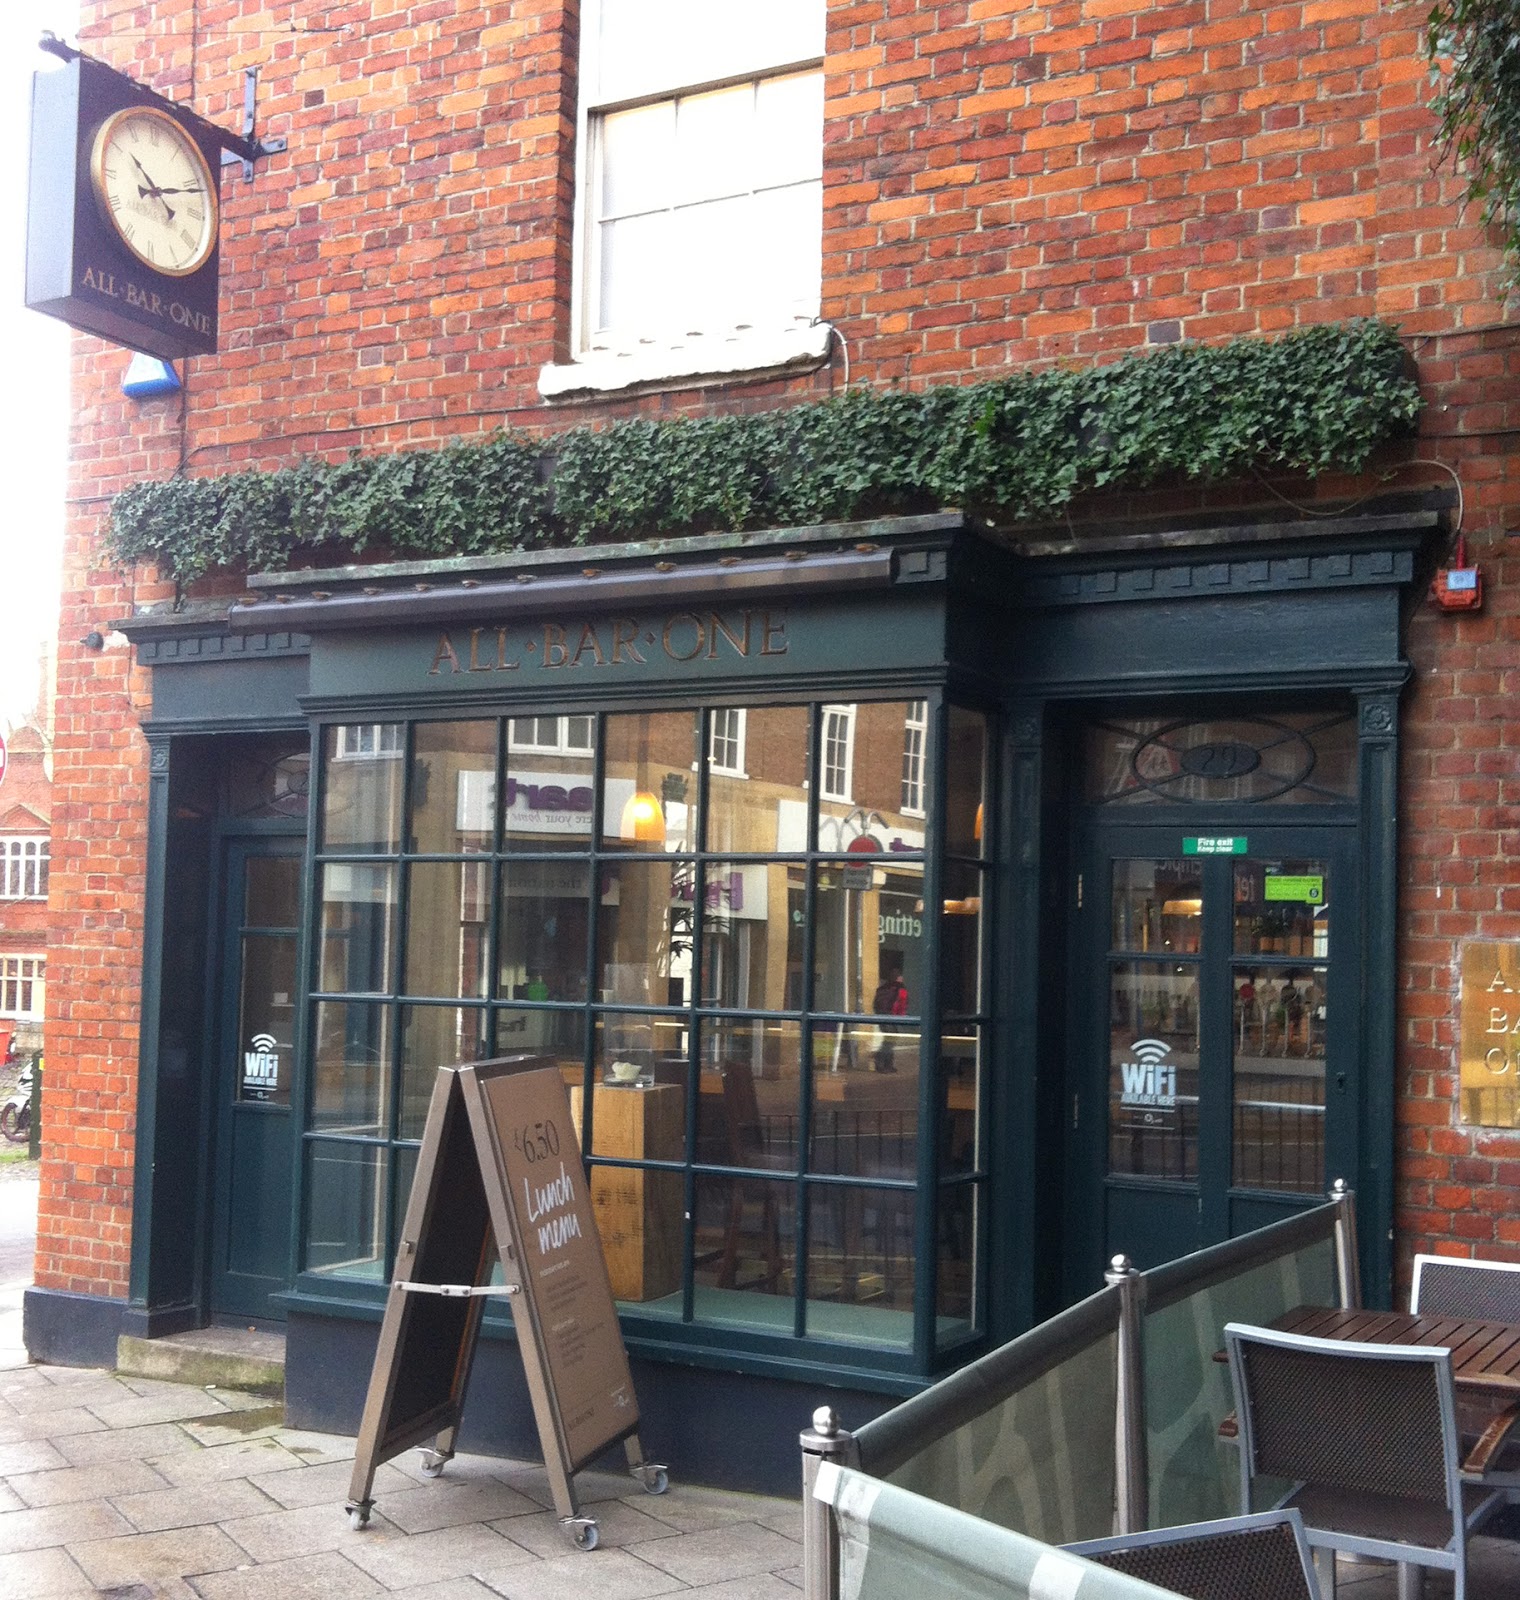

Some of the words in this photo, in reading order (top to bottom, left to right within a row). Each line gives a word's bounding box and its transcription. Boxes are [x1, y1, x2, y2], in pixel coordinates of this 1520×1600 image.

[83, 266, 118, 297] ALL
[126, 282, 163, 317] BAR
[169, 302, 211, 336] ONE
[426, 626, 519, 675] ALL
[541, 617, 646, 669] BAR
[661, 609, 790, 661] ONE
[1197, 837, 1215, 846] Fire
[1216, 836, 1234, 846] exit
[1121, 1063, 1176, 1095] WiFi
[524, 1161, 575, 1222] Lunch
[538, 1213, 582, 1255] menu
